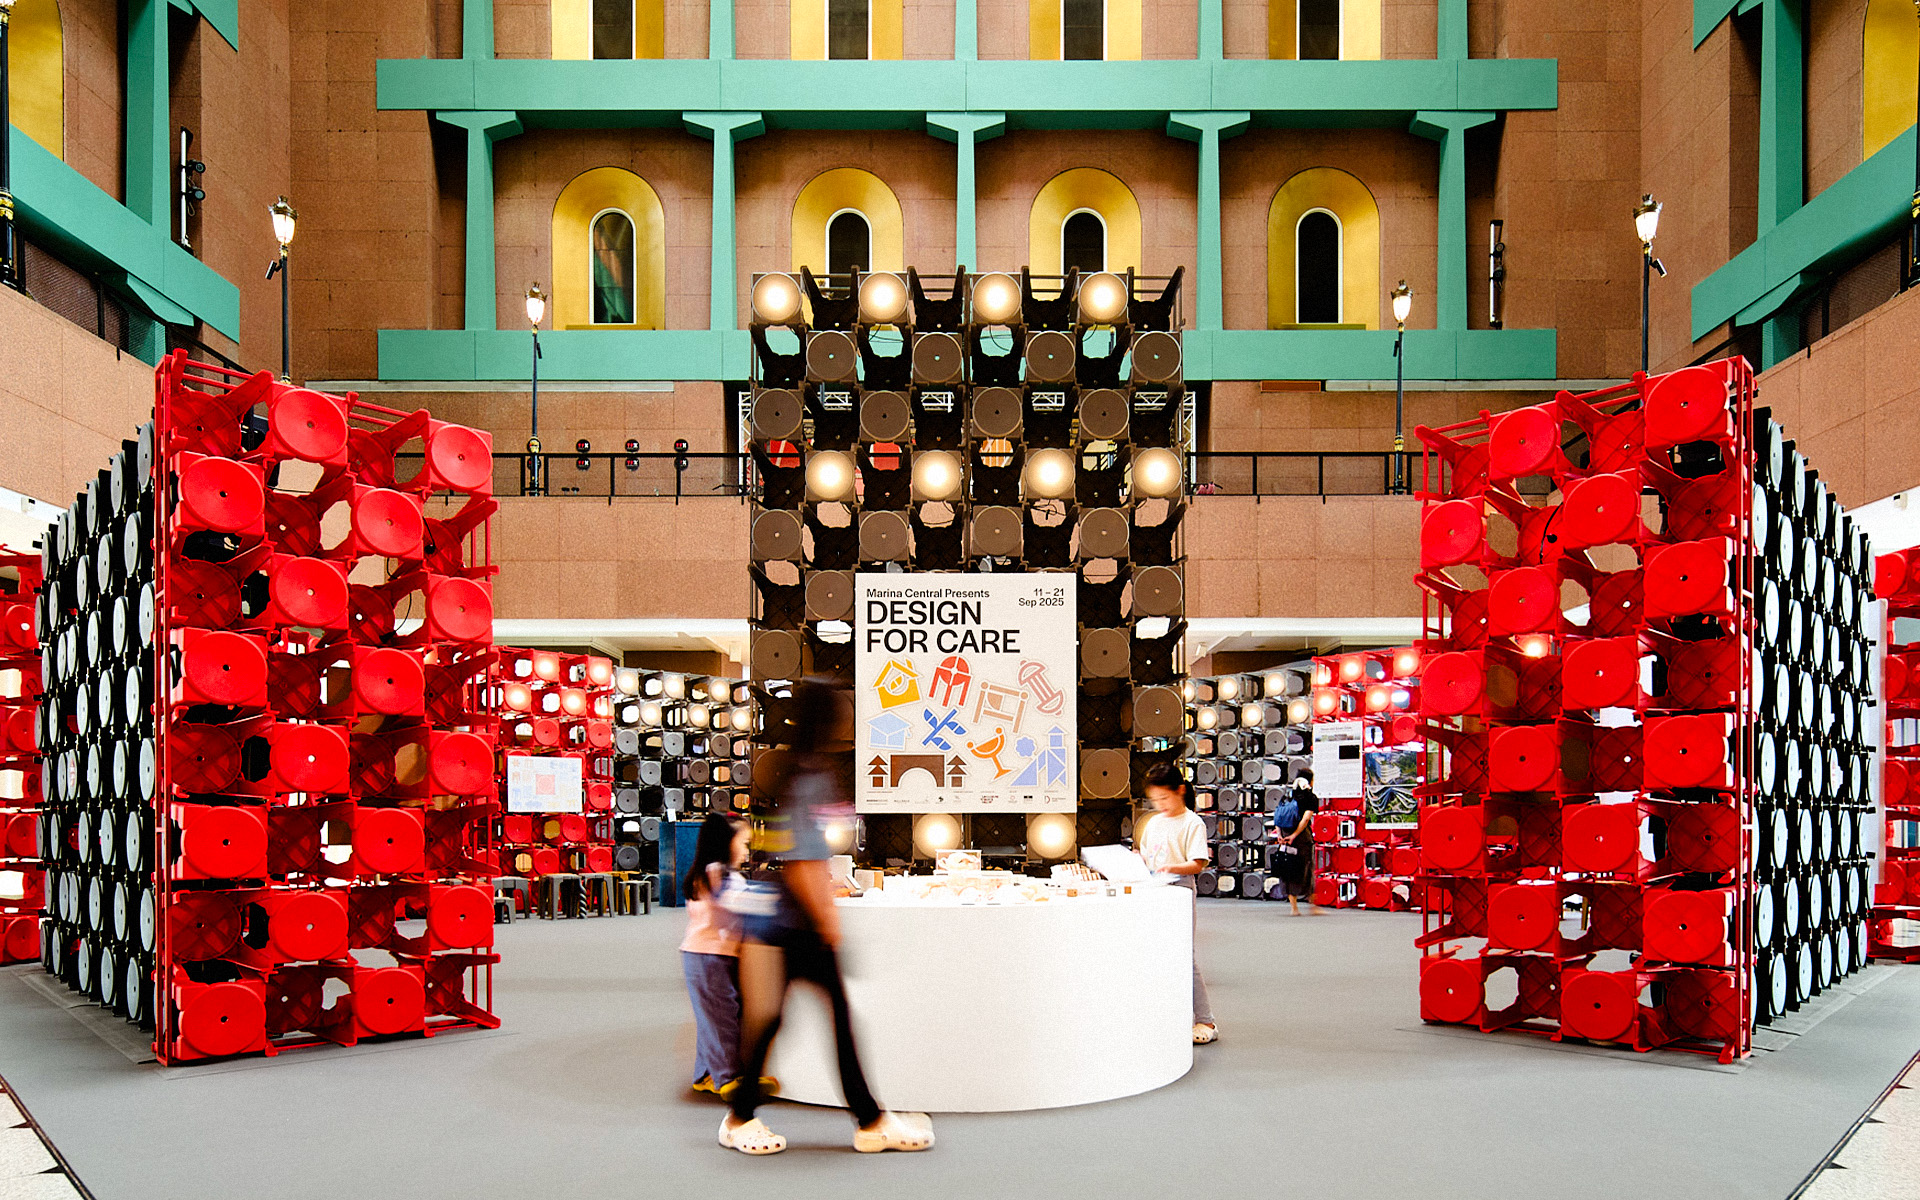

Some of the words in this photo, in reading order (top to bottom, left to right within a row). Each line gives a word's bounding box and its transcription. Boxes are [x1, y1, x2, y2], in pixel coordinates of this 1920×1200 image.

[866, 588, 903, 598] Marina
[904, 588, 943, 598] Central
[945, 588, 990, 598] Presents
[1034, 588, 1043, 597] 11
[1053, 587, 1064, 597] 21
[1018, 597, 1037, 608] Sep
[1039, 597, 1065, 607] 2025
[866, 600, 982, 626] DESIGN
[866, 628, 929, 654] FOR
[936, 628, 1021, 654] CARE
